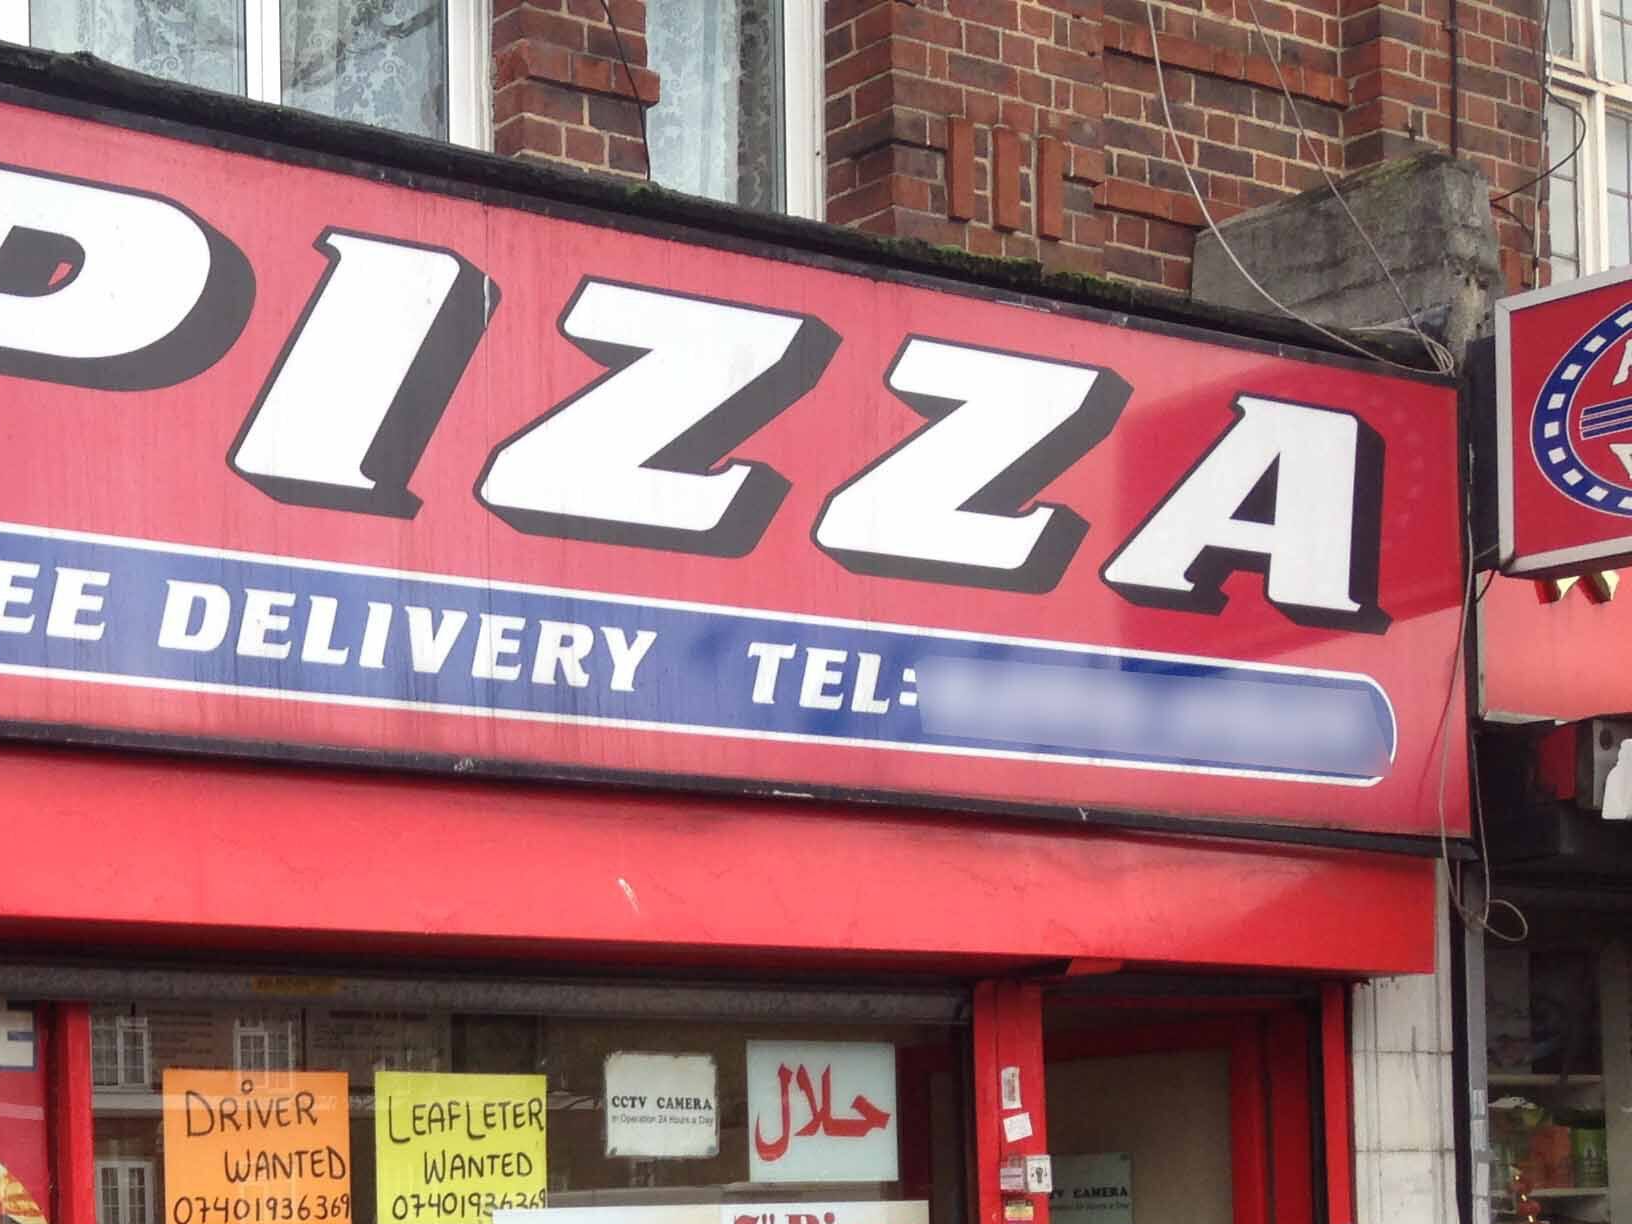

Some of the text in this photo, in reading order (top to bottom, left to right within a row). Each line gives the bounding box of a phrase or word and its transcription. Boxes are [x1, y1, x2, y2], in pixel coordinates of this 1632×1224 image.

[158, 578, 656, 691] DELIVERY
[388, 1095, 545, 1143] LEAFLETER
[611, 1095, 713, 1110] CCTV CAMERA
[755, 1062, 890, 1161] حلال
[223, 1145, 346, 1183] WANTED
[424, 1151, 533, 1184] WANTED
